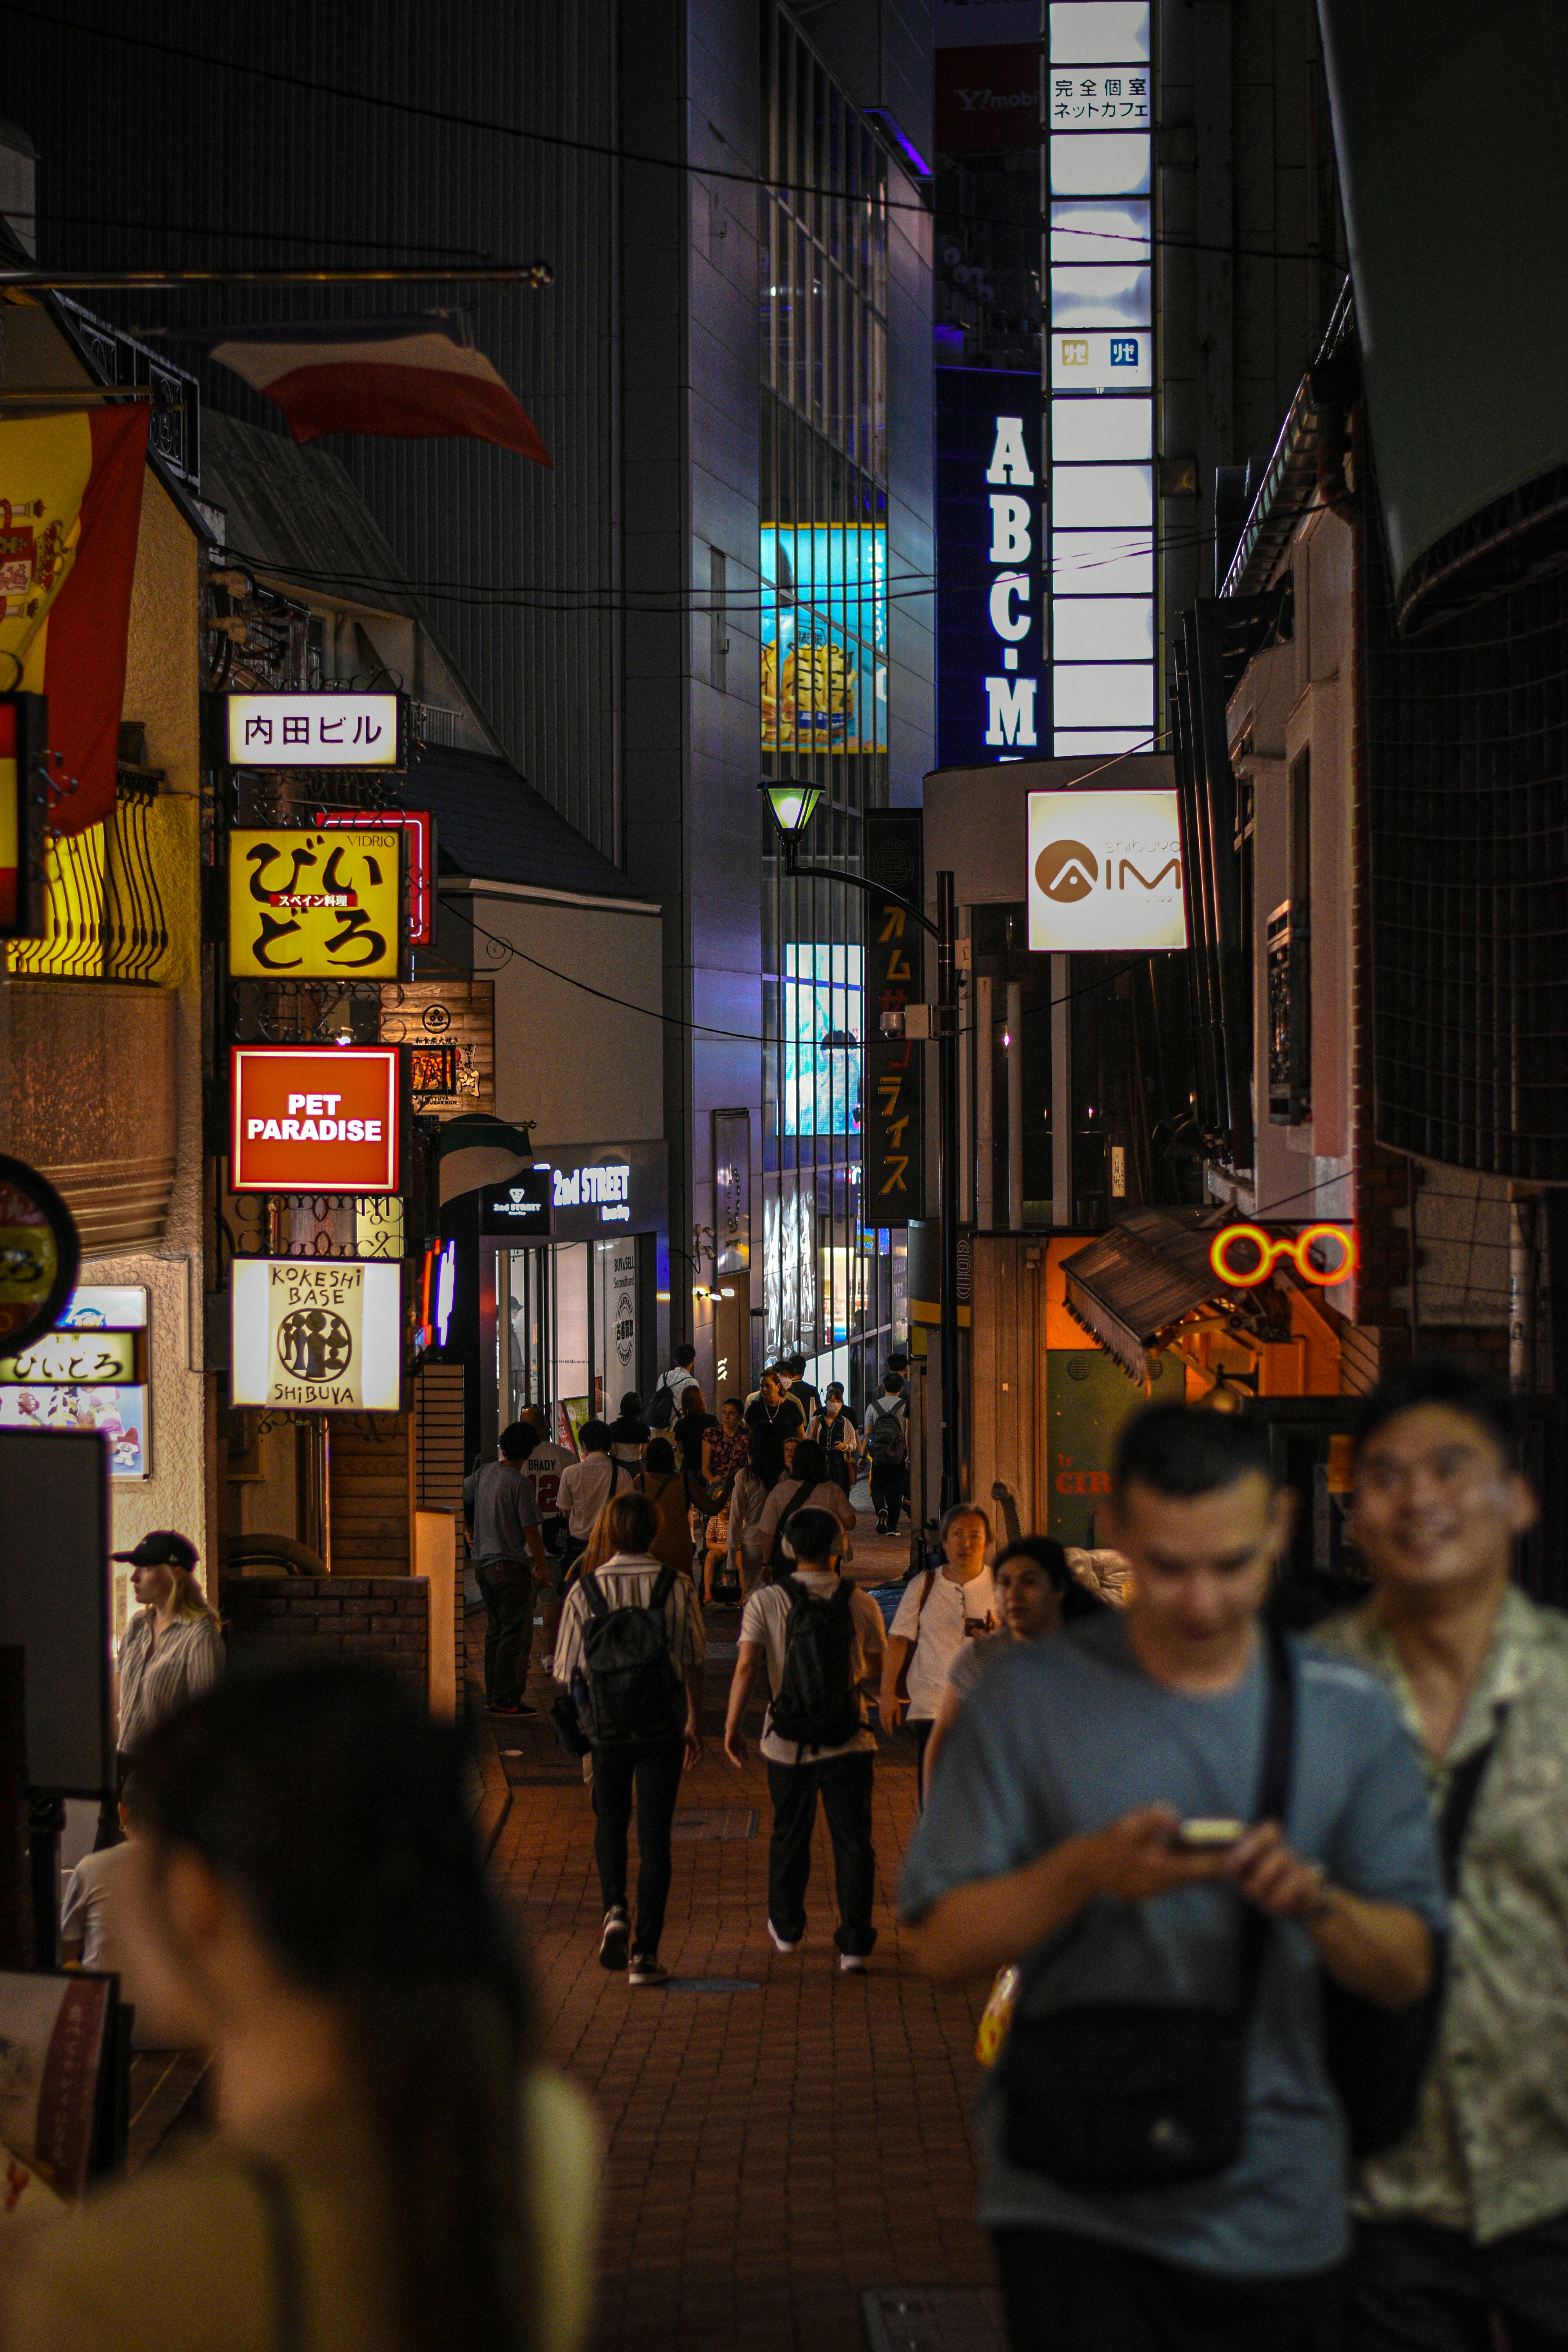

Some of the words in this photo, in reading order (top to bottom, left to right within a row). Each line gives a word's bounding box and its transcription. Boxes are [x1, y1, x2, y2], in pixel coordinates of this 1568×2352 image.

[1056, 79, 1146, 97] 完全個室
[1054, 102, 1147, 118] ネットカフェ
[1114, 343, 1134, 363] リゼ
[985, 416, 1037, 761] ABC-M
[245, 716, 382, 746] 内田ビル
[347, 835, 395, 848] VIDRIO
[279, 895, 348, 907] スペイン料理
[252, 907, 387, 970] どろ
[288, 1094, 341, 1116] PET
[247, 1119, 382, 1142] PARADISE
[554, 1169, 580, 1206] 2nd
[581, 1165, 630, 1203] STREET
[289, 1287, 345, 1306] BASE
[528, 1459, 556, 1471] BRADY
[1055, 1471, 1120, 1495] CIR
